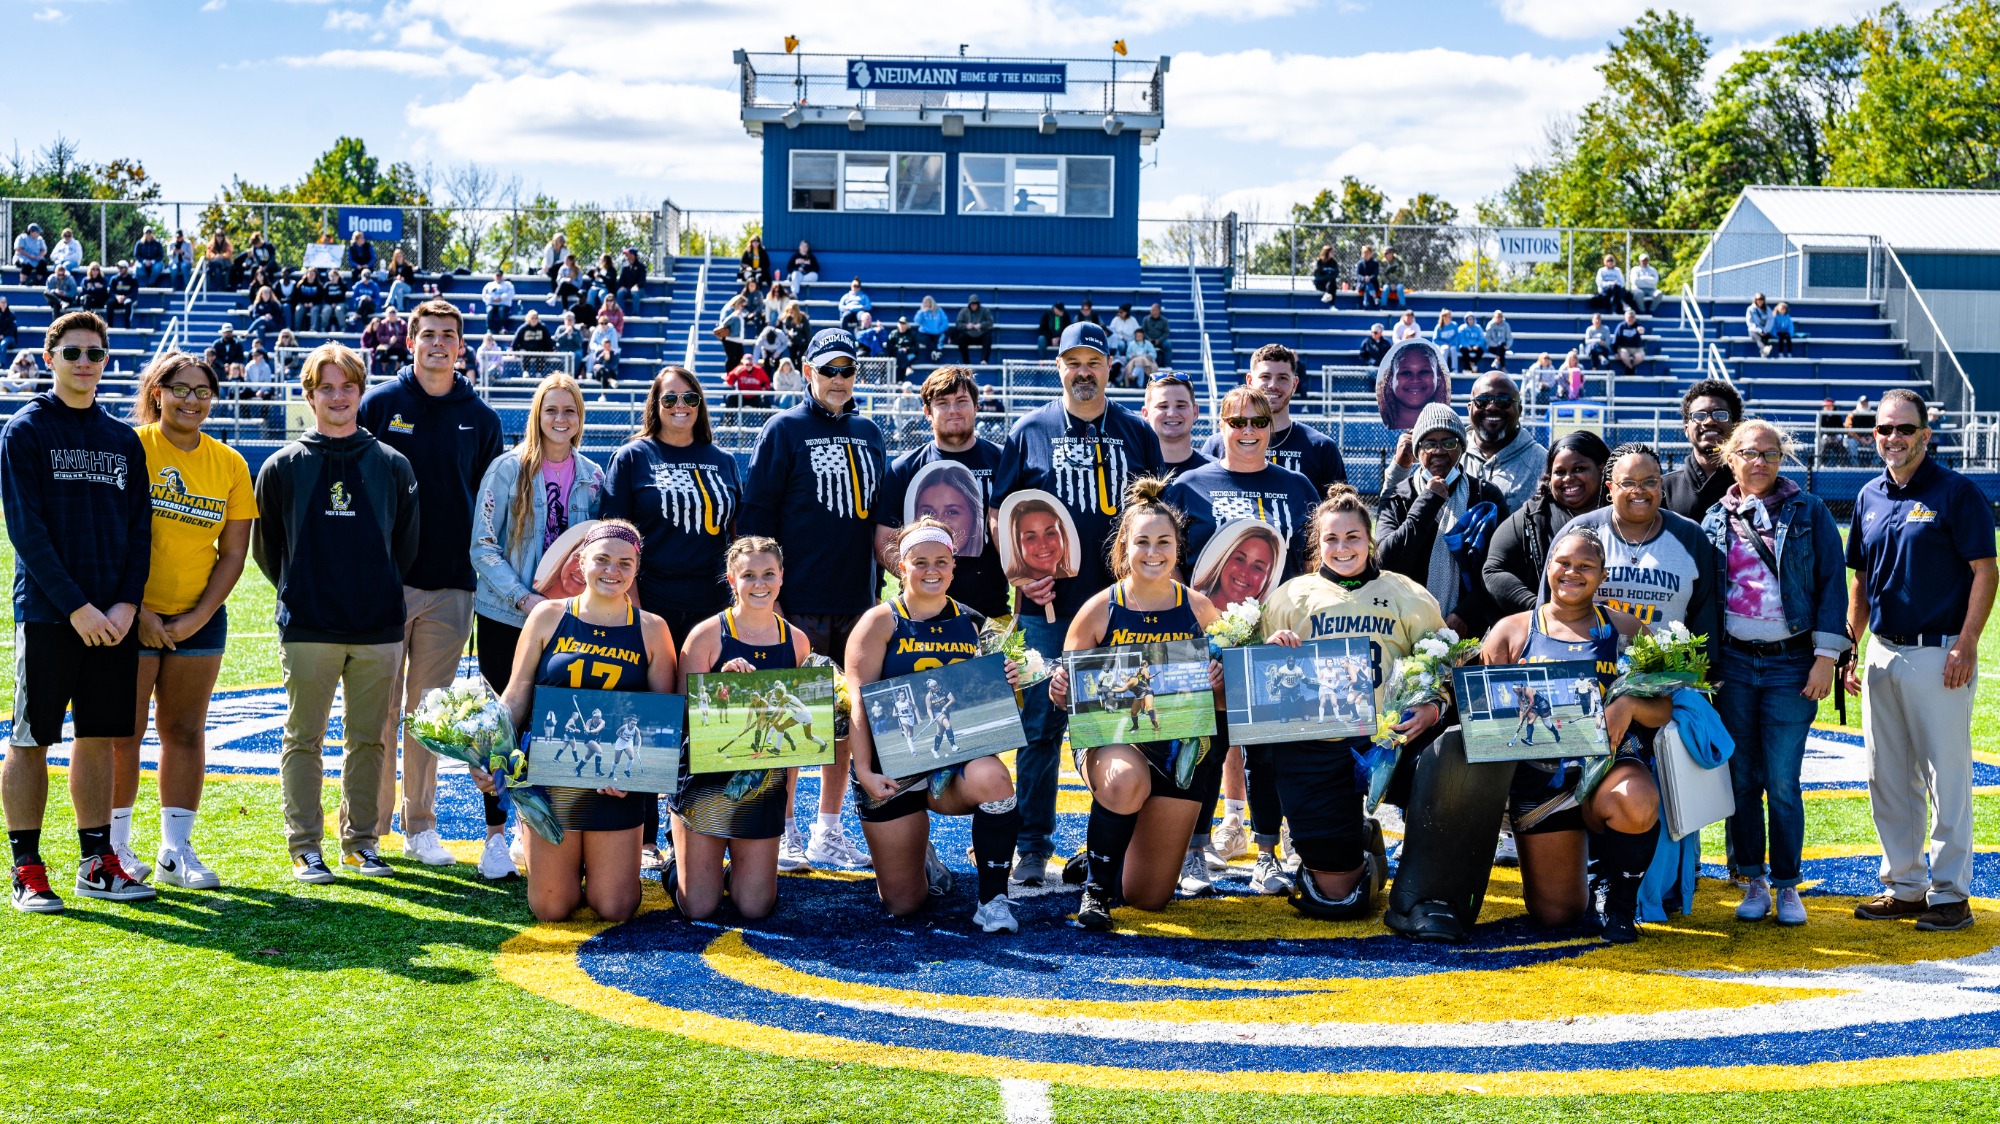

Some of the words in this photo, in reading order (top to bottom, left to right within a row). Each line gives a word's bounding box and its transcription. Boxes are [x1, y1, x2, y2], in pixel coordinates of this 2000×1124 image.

[874, 67, 958, 85] NEUMANN
[960, 72, 987, 83] HOME
[988, 72, 999, 83] OF
[1002, 73, 1020, 84] THE
[1022, 73, 1062, 84] KNIGHTS
[348, 215, 393, 232] Home
[1500, 237, 1559, 254] VISITORS
[819, 333, 854, 349] NEUMANN
[833, 436, 850, 444] FIELD
[1279, 450, 1302, 458] HOCKEY
[150, 485, 225, 513] NEUMANN
[1241, 490, 1262, 498] FIELD
[150, 498, 191, 513] NIVERSITY
[191, 507, 222, 520] KNIGHTS
[179, 515, 216, 529] HOCKEY
[1597, 587, 1624, 598] IELD
[1626, 589, 1675, 602] HOCKEY
[1310, 612, 1396, 639] NEUMANN
[552, 636, 641, 665] NEUMANN
[896, 637, 977, 655] NEUMANN
[567, 658, 623, 691] 17
